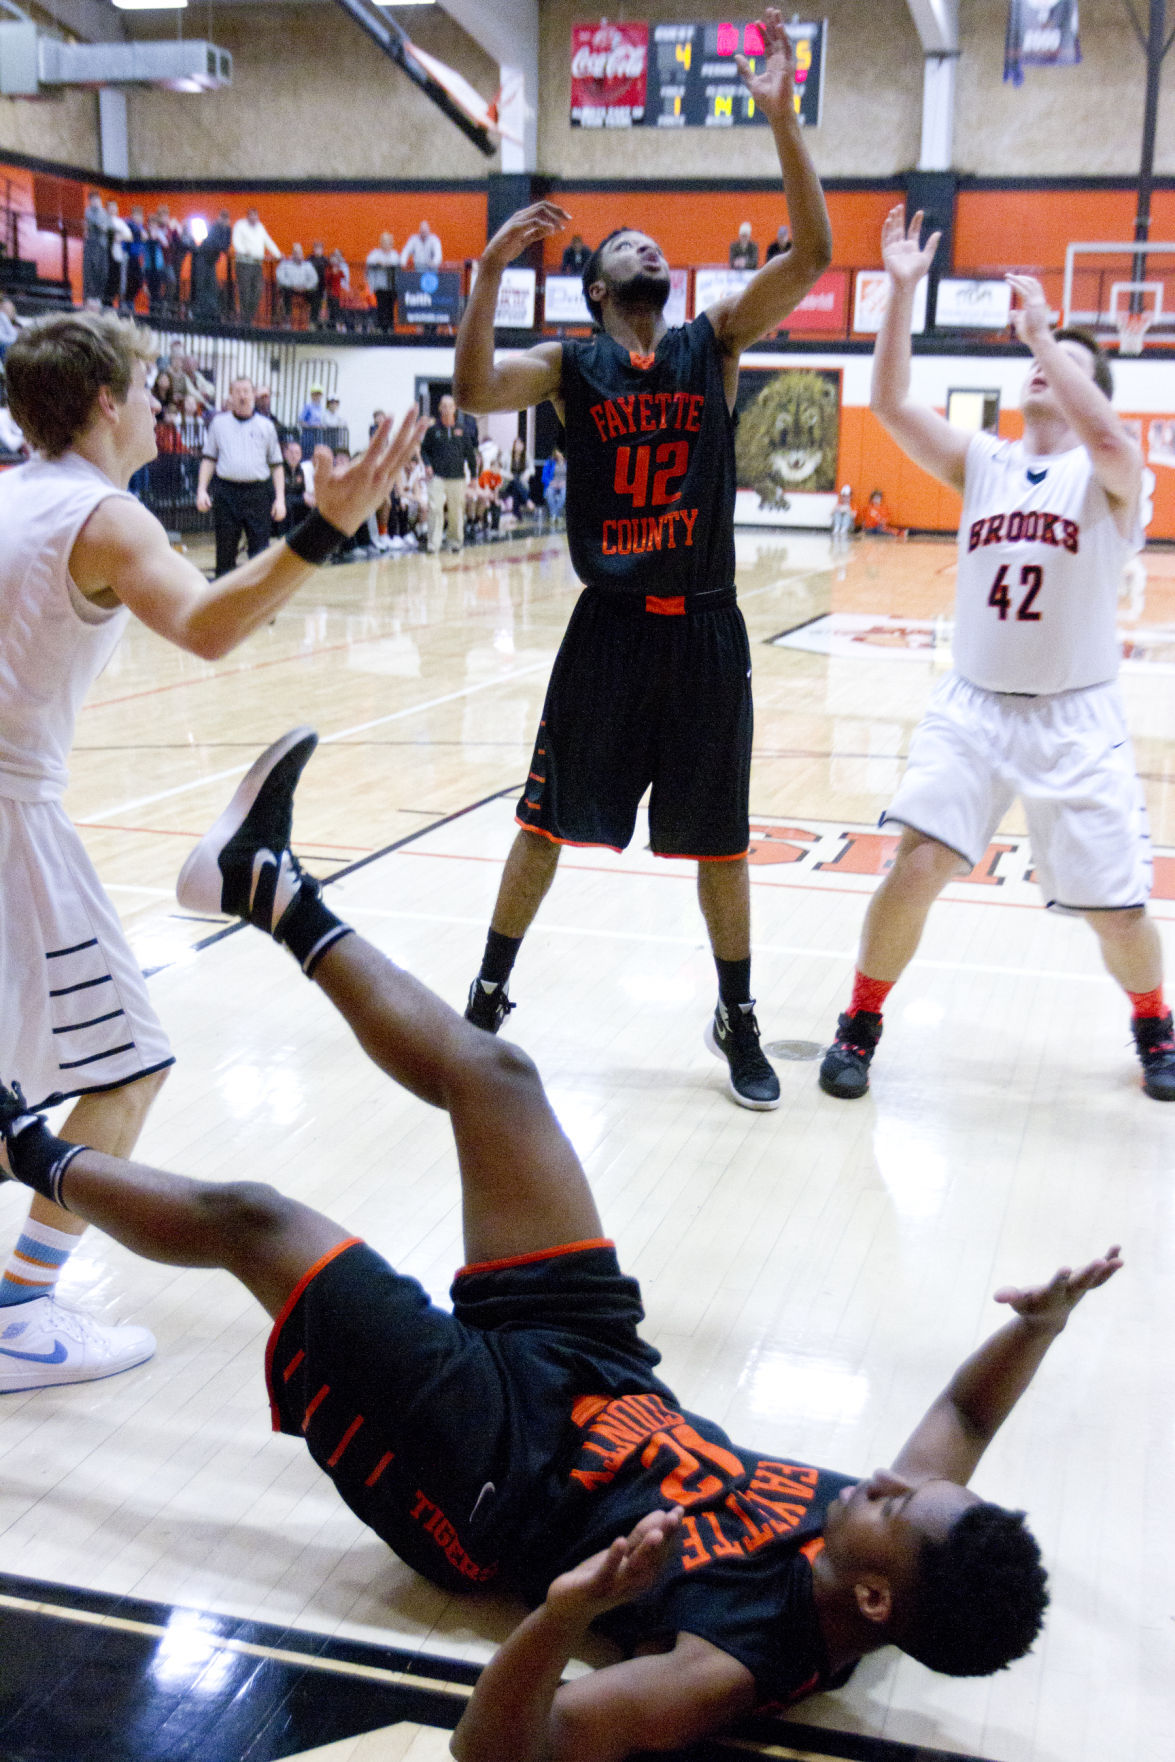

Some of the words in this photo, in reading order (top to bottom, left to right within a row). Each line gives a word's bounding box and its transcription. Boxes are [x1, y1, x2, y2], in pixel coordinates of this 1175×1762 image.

[589, 391, 705, 443] FAYETTE
[613, 440, 689, 508] 42
[601, 508, 699, 555] COUNTY
[967, 511, 1079, 554] BROOKS
[987, 564, 1044, 621] 42
[569, 1393, 686, 1491] COUNTY
[681, 1460, 819, 1571] FAYTTE
